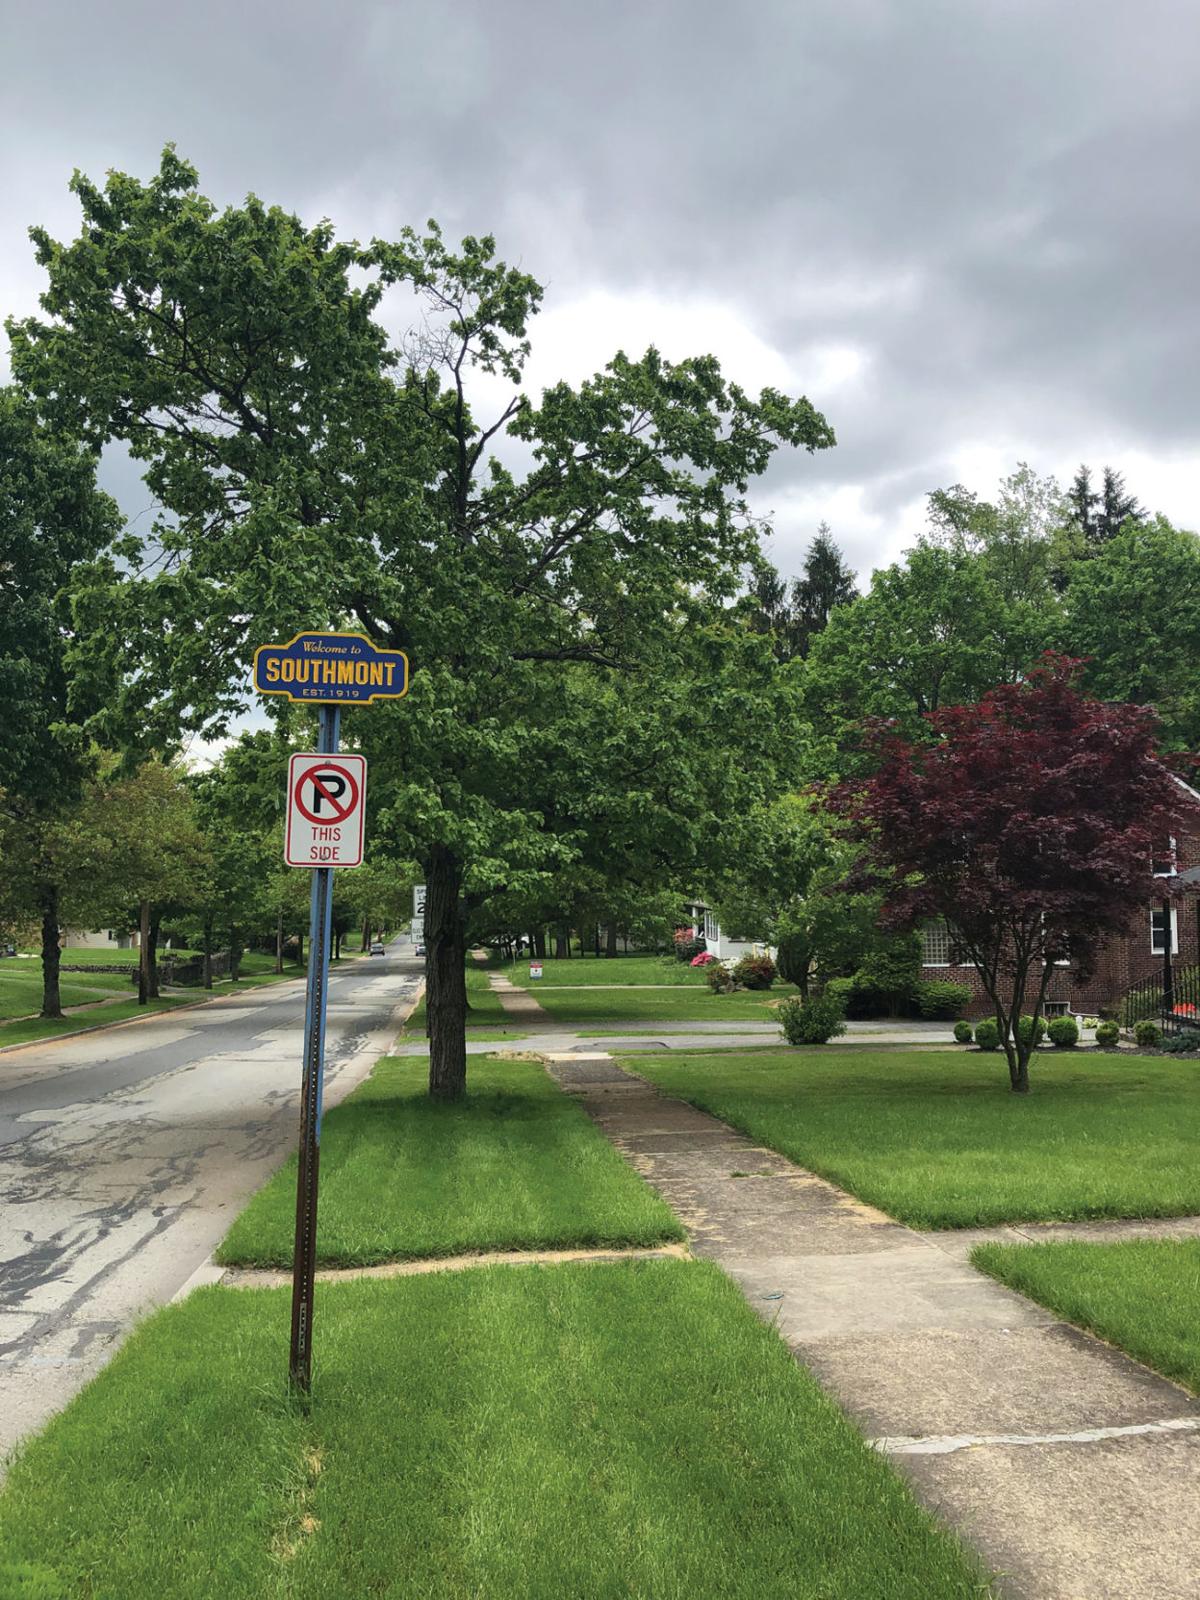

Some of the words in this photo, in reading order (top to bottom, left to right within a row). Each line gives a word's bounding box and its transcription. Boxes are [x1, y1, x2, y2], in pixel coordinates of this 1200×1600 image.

[303, 640, 348, 654] Welcome
[351, 644, 361, 655] to
[266, 657, 396, 686] SOUTHMONT
[302, 688, 326, 697] EST.
[330, 689, 360, 698] 1919
[311, 826, 341, 841] THIS
[310, 846, 340, 861] SIDE
[417, 902, 426, 914] 2
